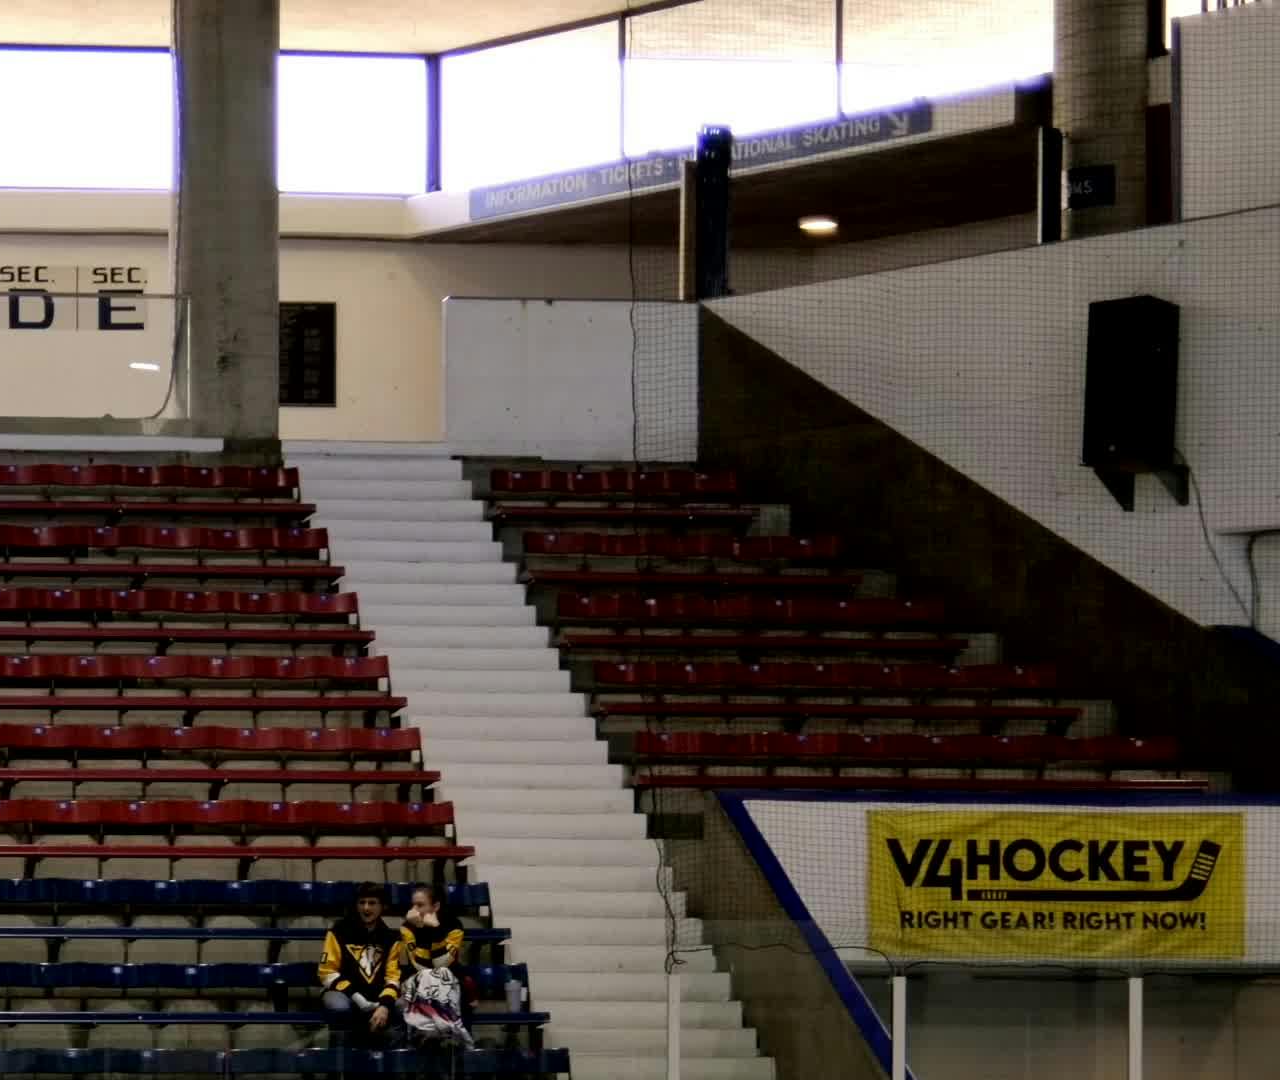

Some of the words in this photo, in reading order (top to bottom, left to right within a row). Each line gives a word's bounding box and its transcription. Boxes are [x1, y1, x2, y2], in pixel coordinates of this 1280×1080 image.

[485, 174, 588, 209] INFORMATION
[599, 156, 663, 185] TICKETS
[802, 116, 881, 147] SKATING
[0, 265, 56, 283] SEC.
[92, 267, 148, 284] SEC.
[8, 288, 55, 329] D
[98, 289, 144, 330] E
[900, 910, 974, 930] RIGHT
[979, 911, 1055, 930] GEAR!
[1063, 911, 1135, 930] RIGHT
[1142, 911, 1208, 931] NOW!
